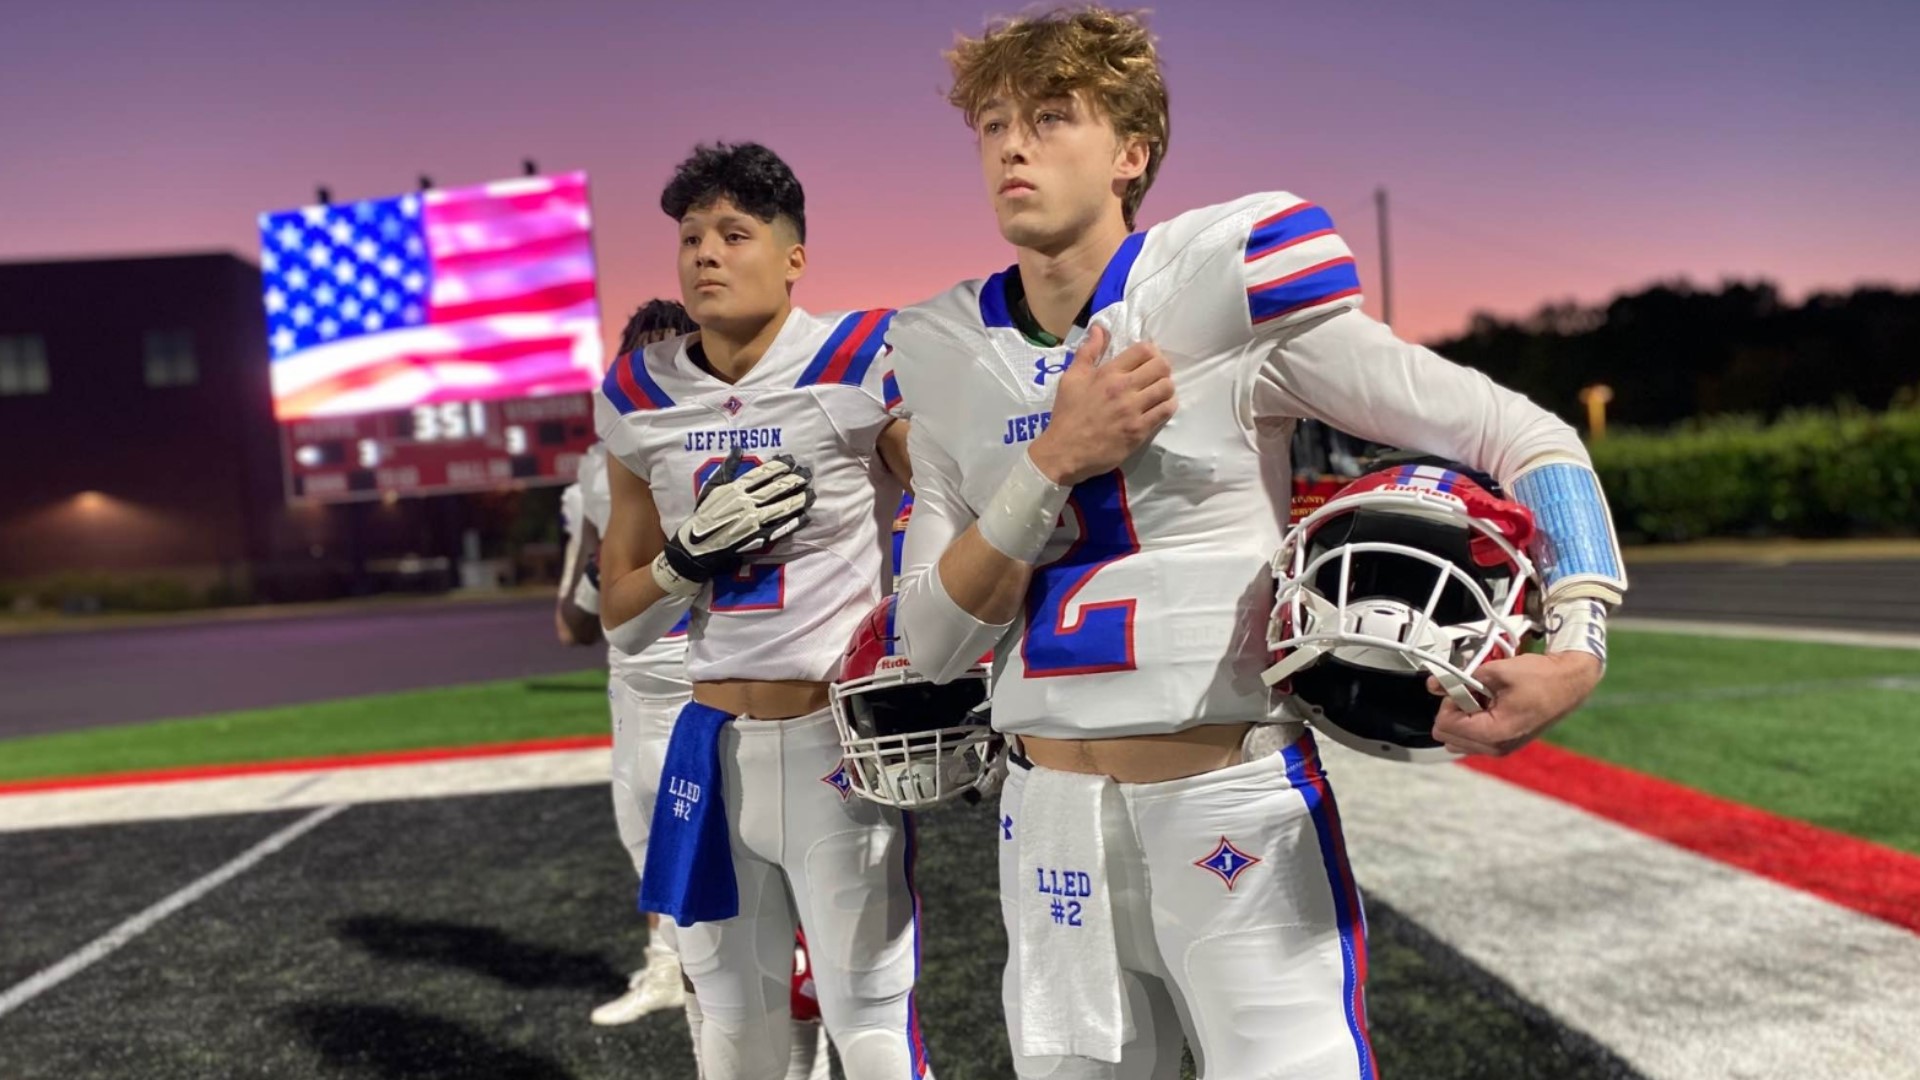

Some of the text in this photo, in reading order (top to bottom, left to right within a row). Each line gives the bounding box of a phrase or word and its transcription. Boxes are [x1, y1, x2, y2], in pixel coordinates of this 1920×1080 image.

[684, 428, 782, 451] JEFFERSON
[1023, 467, 1141, 678] 2
[668, 775, 701, 803] LLED
[673, 798, 692, 821] #2
[1217, 852, 1234, 872] J
[1037, 867, 1092, 897] LLED
[1051, 898, 1083, 926] #2
